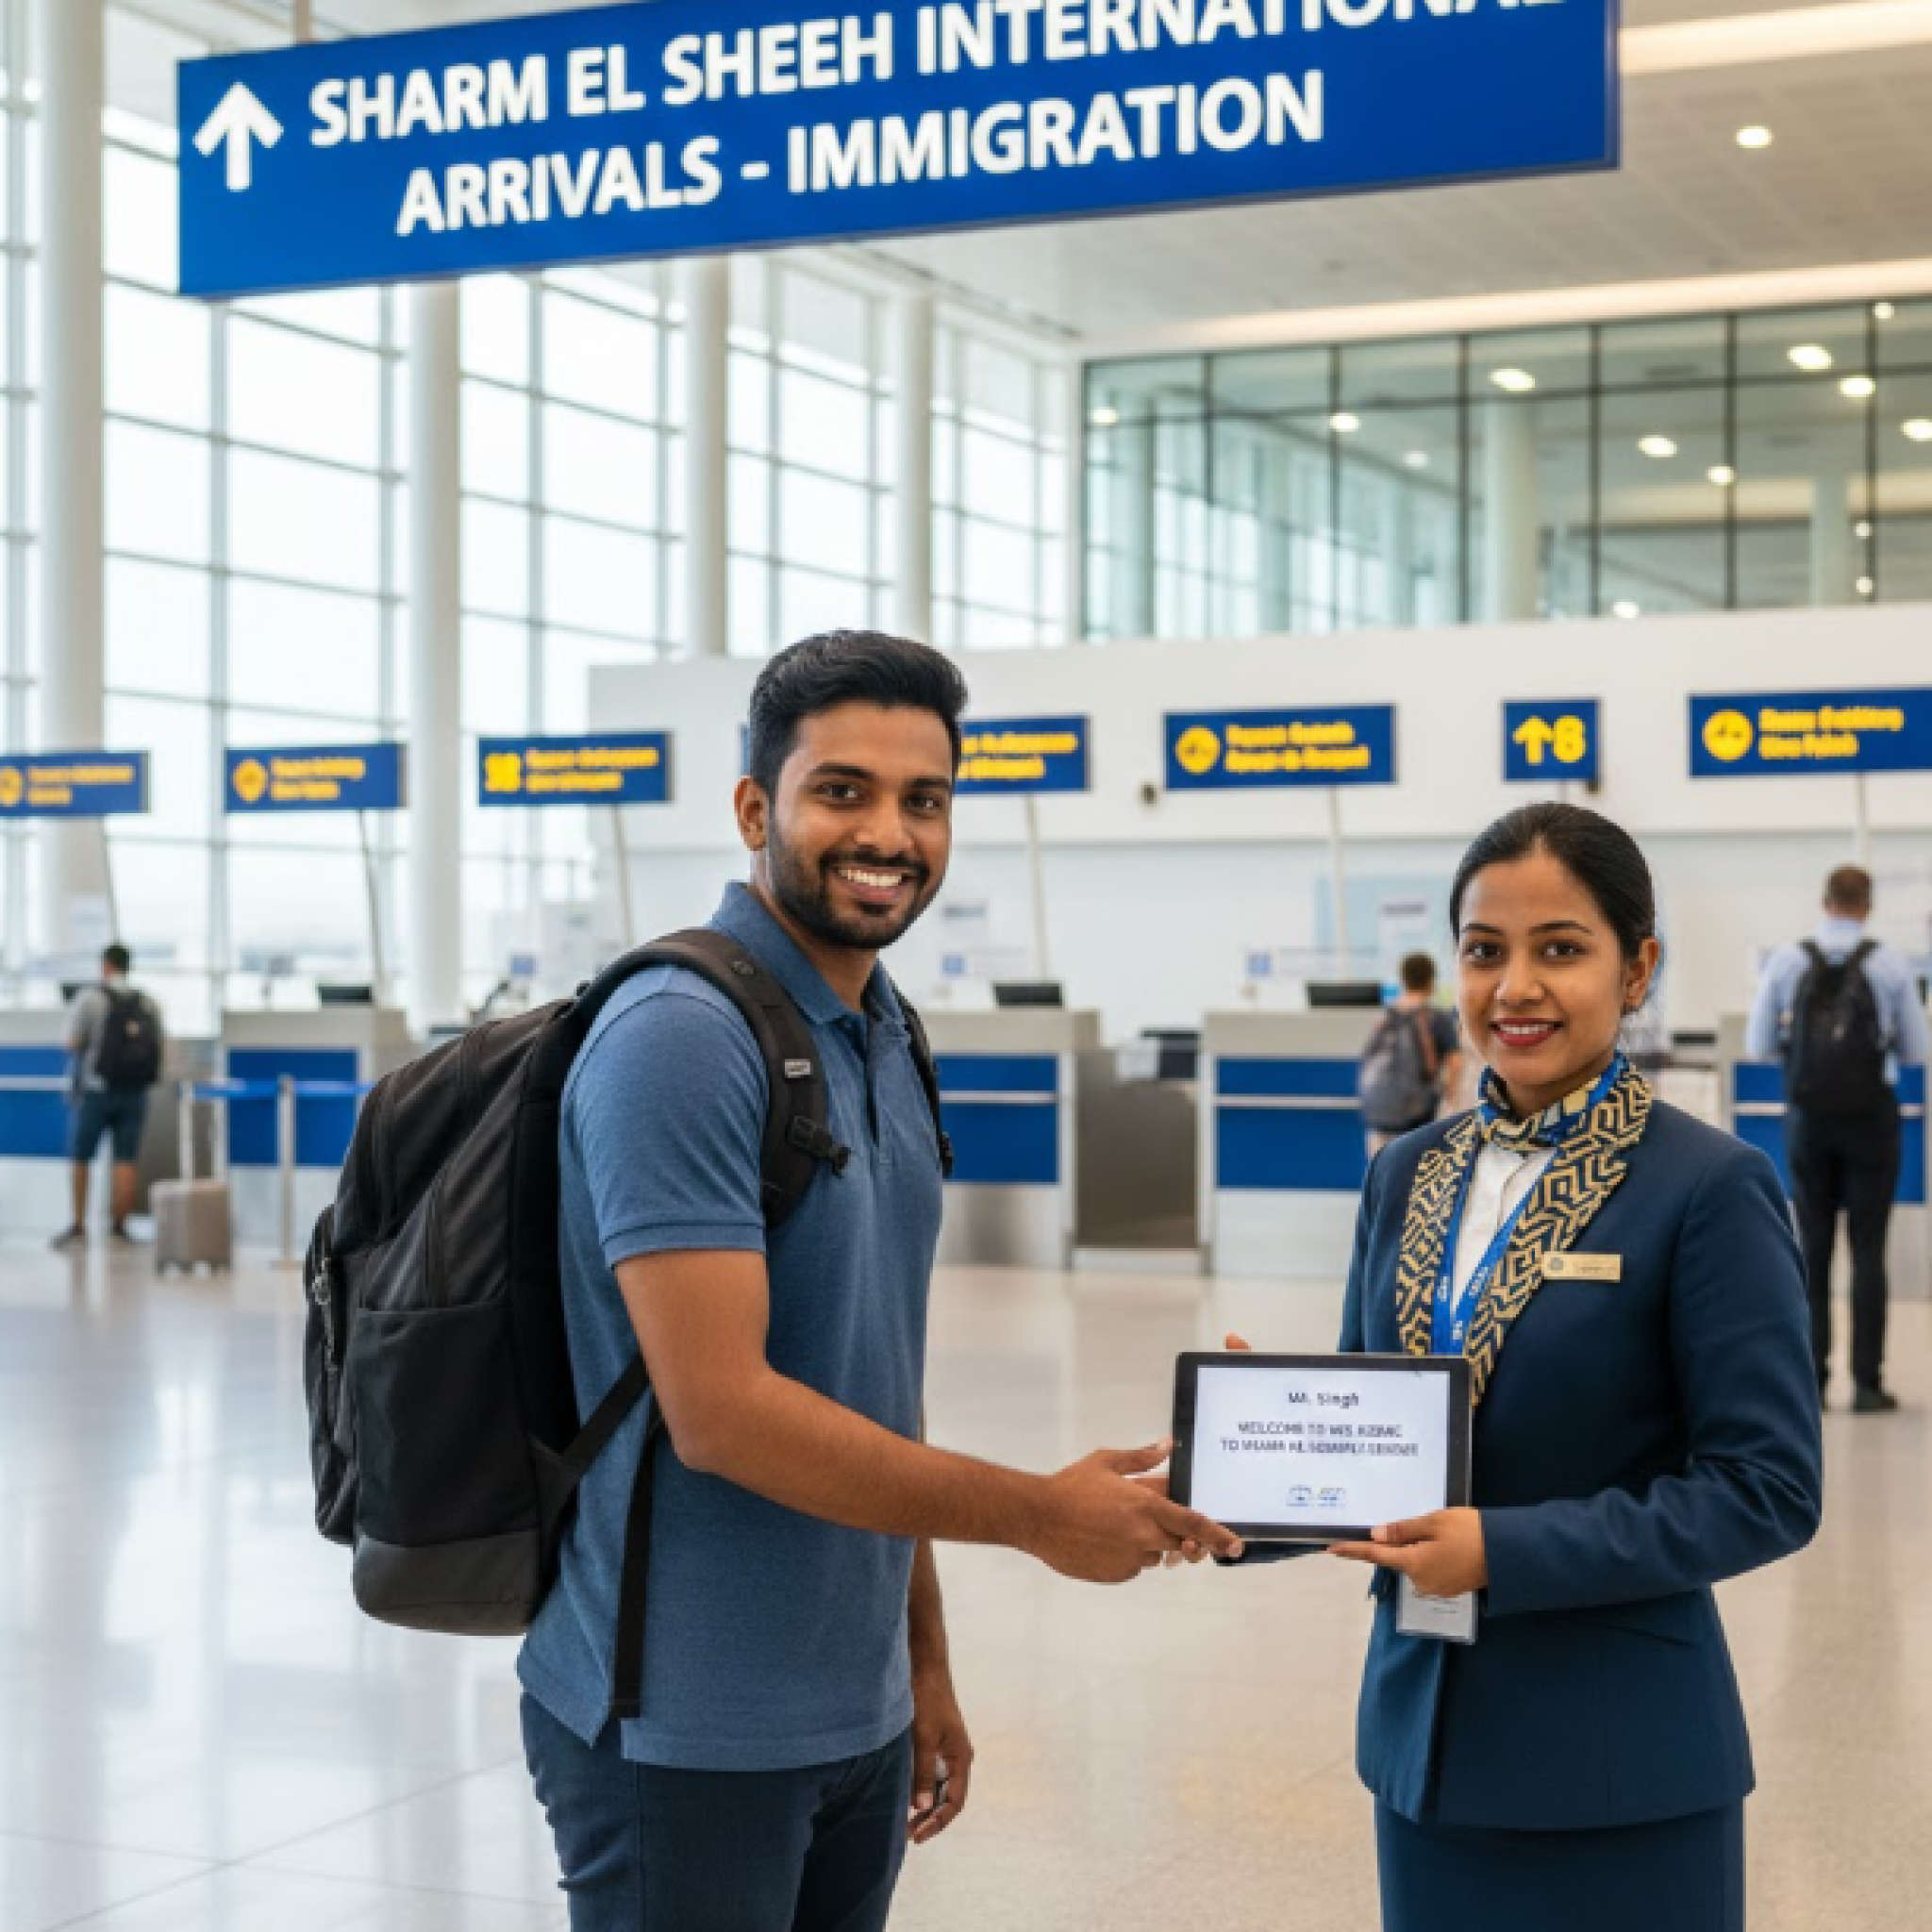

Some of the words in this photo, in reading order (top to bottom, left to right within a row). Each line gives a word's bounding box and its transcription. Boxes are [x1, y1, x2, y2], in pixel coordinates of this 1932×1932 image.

[309, 54, 548, 148] SHARM
[567, 43, 646, 118] EL
[662, 11, 893, 106] SHEEH
[916, 0, 1566, 75] INTERNA
[395, 137, 722, 237] ARRIVALS
[787, 69, 1324, 193] IMMIGRATION
